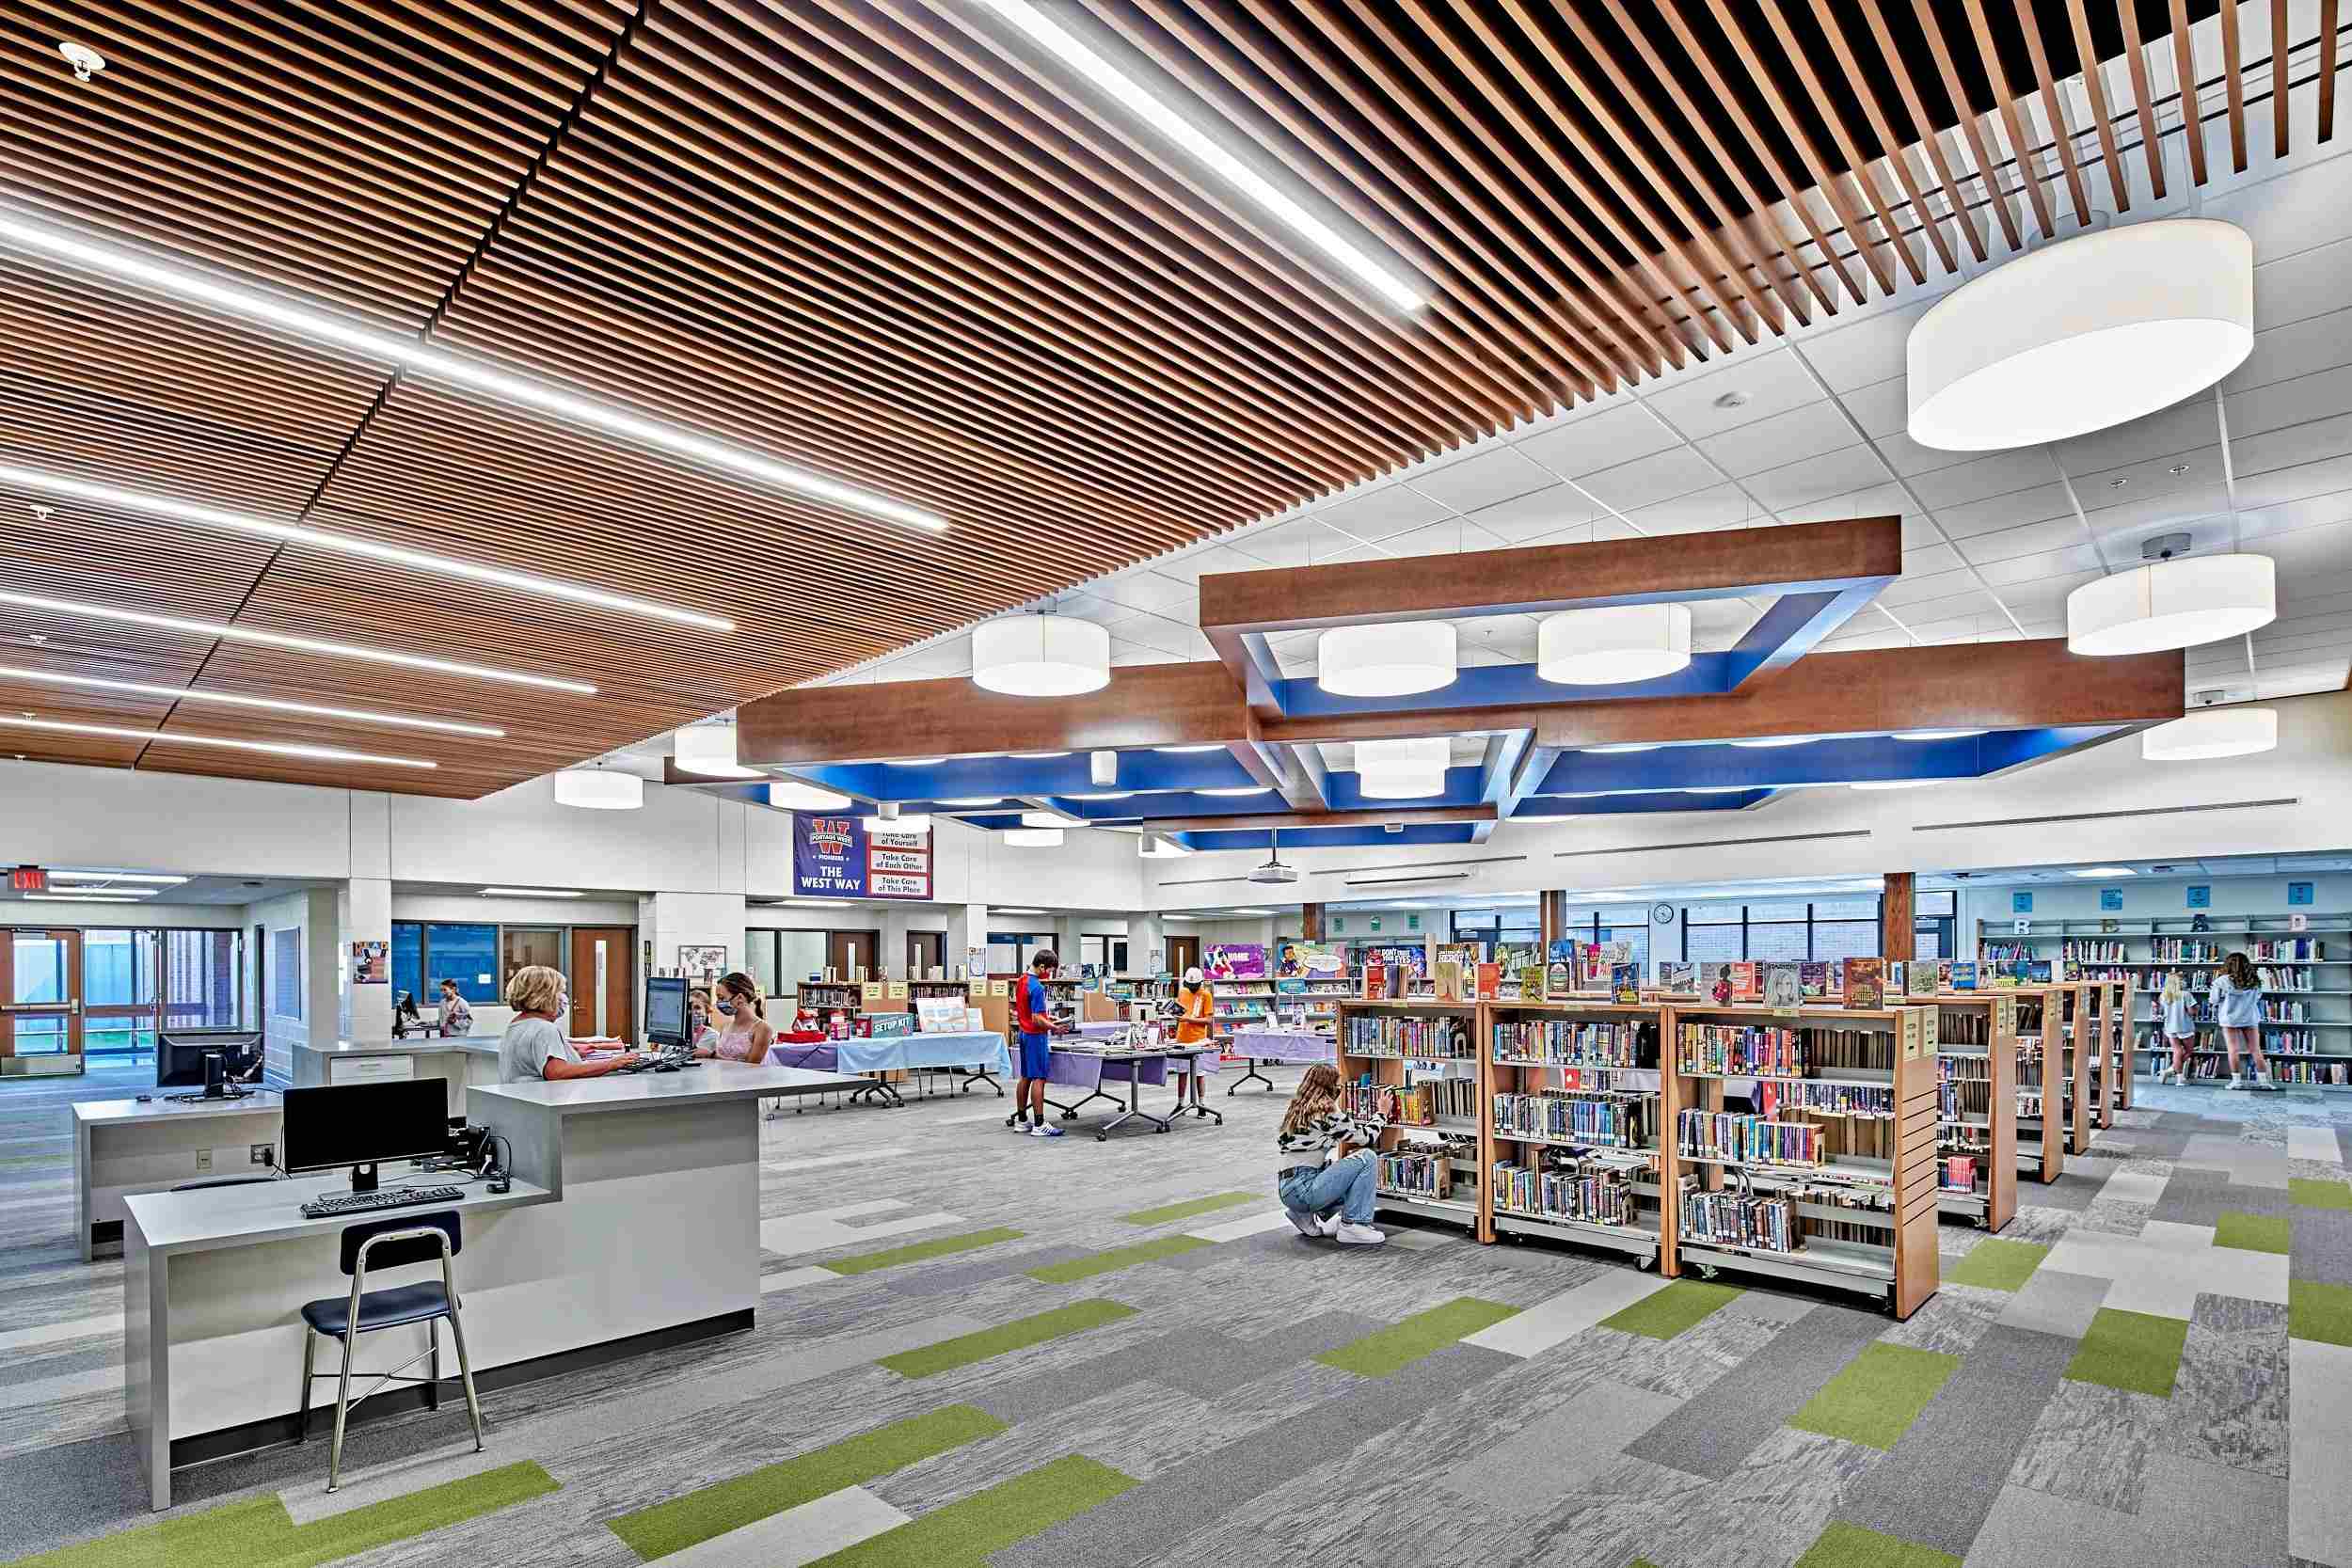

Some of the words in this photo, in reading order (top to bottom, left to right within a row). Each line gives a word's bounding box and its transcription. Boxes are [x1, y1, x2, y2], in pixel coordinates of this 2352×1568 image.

[890, 838, 918, 847] Yourself
[882, 853, 899, 862] Take
[901, 854, 917, 863] Care
[820, 865, 843, 878] THE
[903, 863, 924, 871] Other
[15, 872, 44, 889] EXIT
[801, 876, 833, 889] WEST
[834, 879, 861, 890] WAY
[882, 877, 899, 885] Take
[887, 884, 901, 893] This
[903, 885, 922, 894] Place
[2013, 918, 2032, 935] R
[1395, 955, 1411, 964] EYES
[874, 1021, 897, 1033] SETUP
[898, 1017, 910, 1028] KIT
